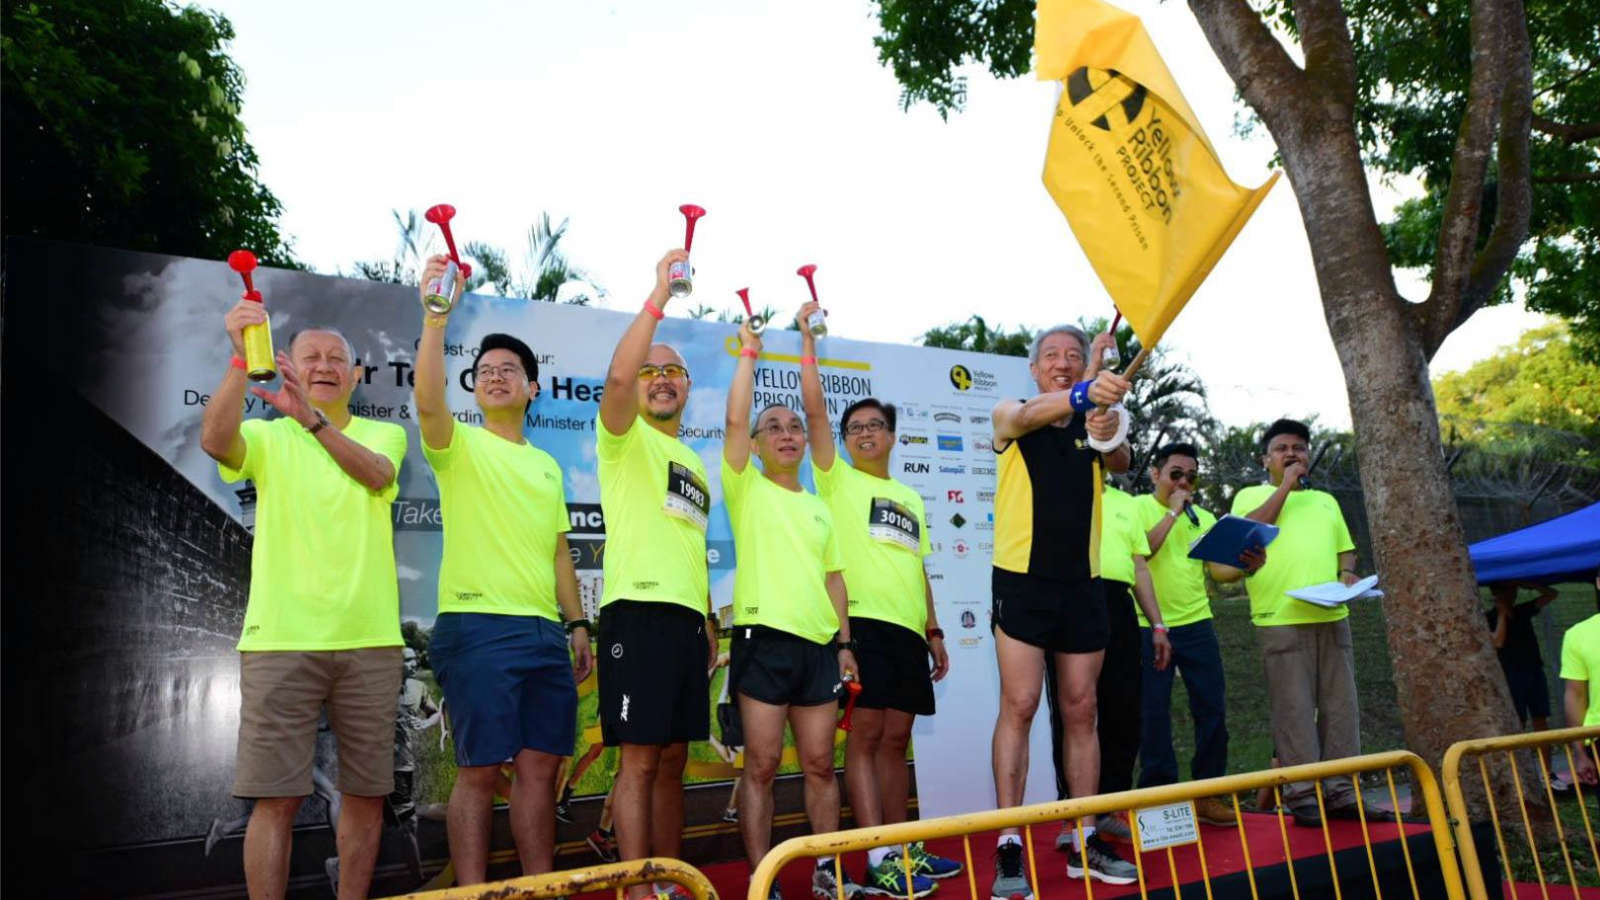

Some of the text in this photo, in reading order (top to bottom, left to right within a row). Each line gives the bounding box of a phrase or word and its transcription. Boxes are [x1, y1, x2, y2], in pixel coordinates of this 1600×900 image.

[1147, 106, 1181, 198] Yellow
[1064, 117, 1097, 152] Unlock
[1093, 153, 1107, 173] the
[1106, 172, 1132, 214] Second
[1128, 214, 1149, 252] Prison
[1116, 145, 1156, 211] PROJECT
[1128, 128, 1173, 226] Ribbon
[552, 376, 604, 402] Hea
[753, 368, 803, 391] YELLO
[399, 403, 411, 420] &
[526, 414, 587, 432] Minister
[903, 462, 930, 474] RUN
[680, 480, 705, 508] 19983
[394, 501, 443, 525] Take
[881, 509, 913, 533] 30100
[1163, 806, 1190, 819] S-LITE
